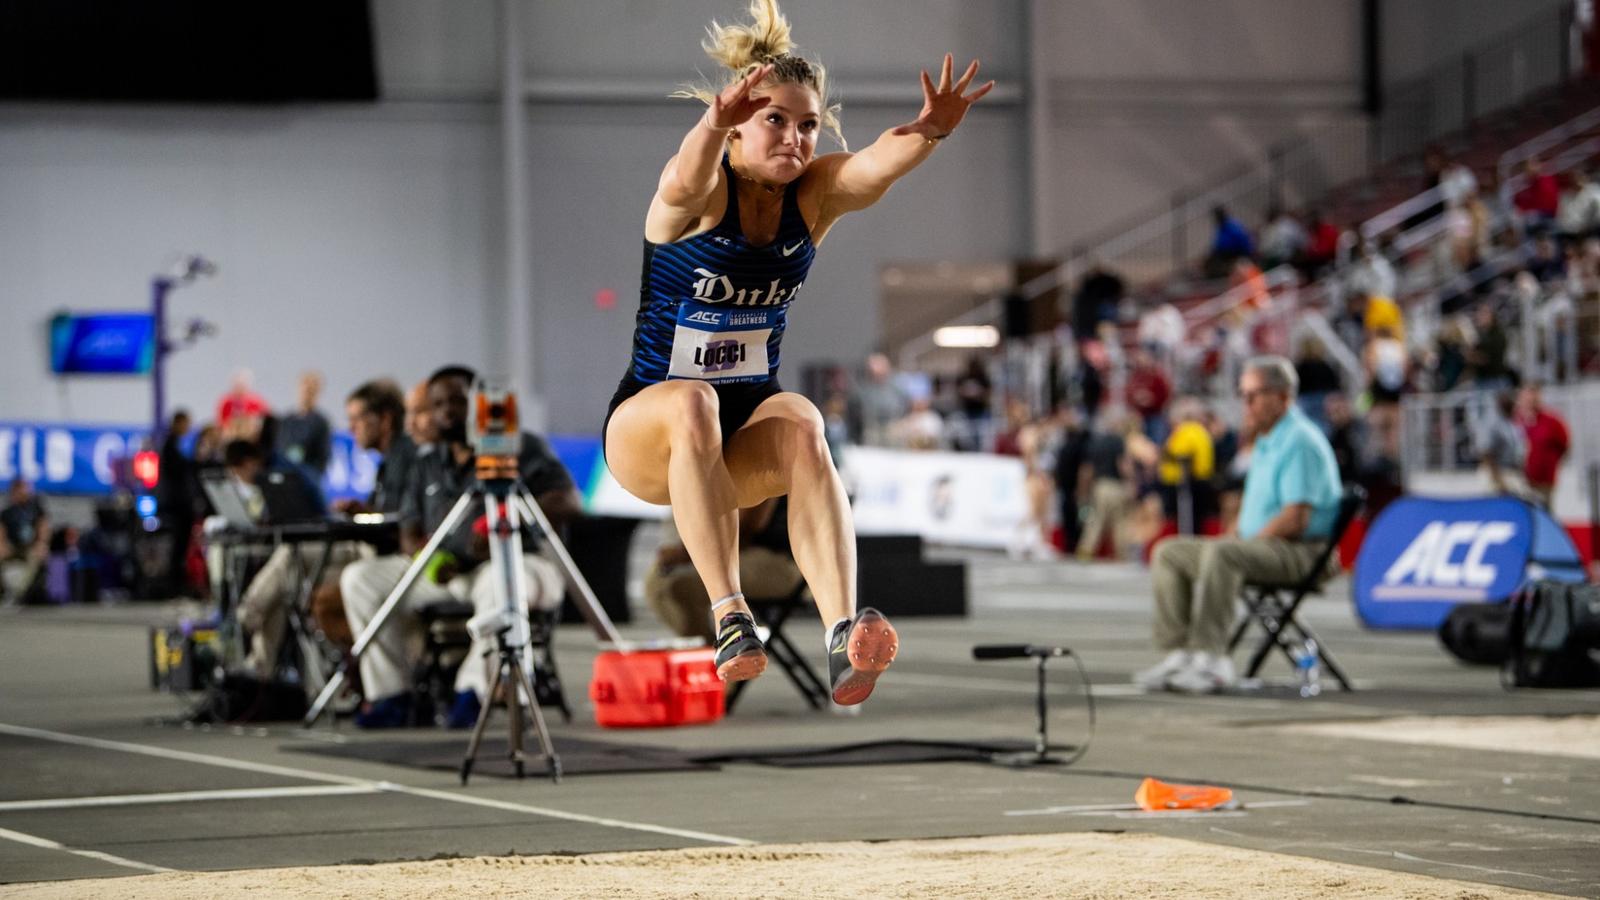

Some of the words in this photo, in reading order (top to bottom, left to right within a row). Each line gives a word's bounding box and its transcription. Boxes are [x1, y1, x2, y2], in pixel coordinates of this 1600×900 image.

[686, 310, 723, 323] ACC
[729, 316, 767, 326] GREATNESS
[694, 343, 746, 367] LOCCI
[1383, 521, 1516, 586] ACC
